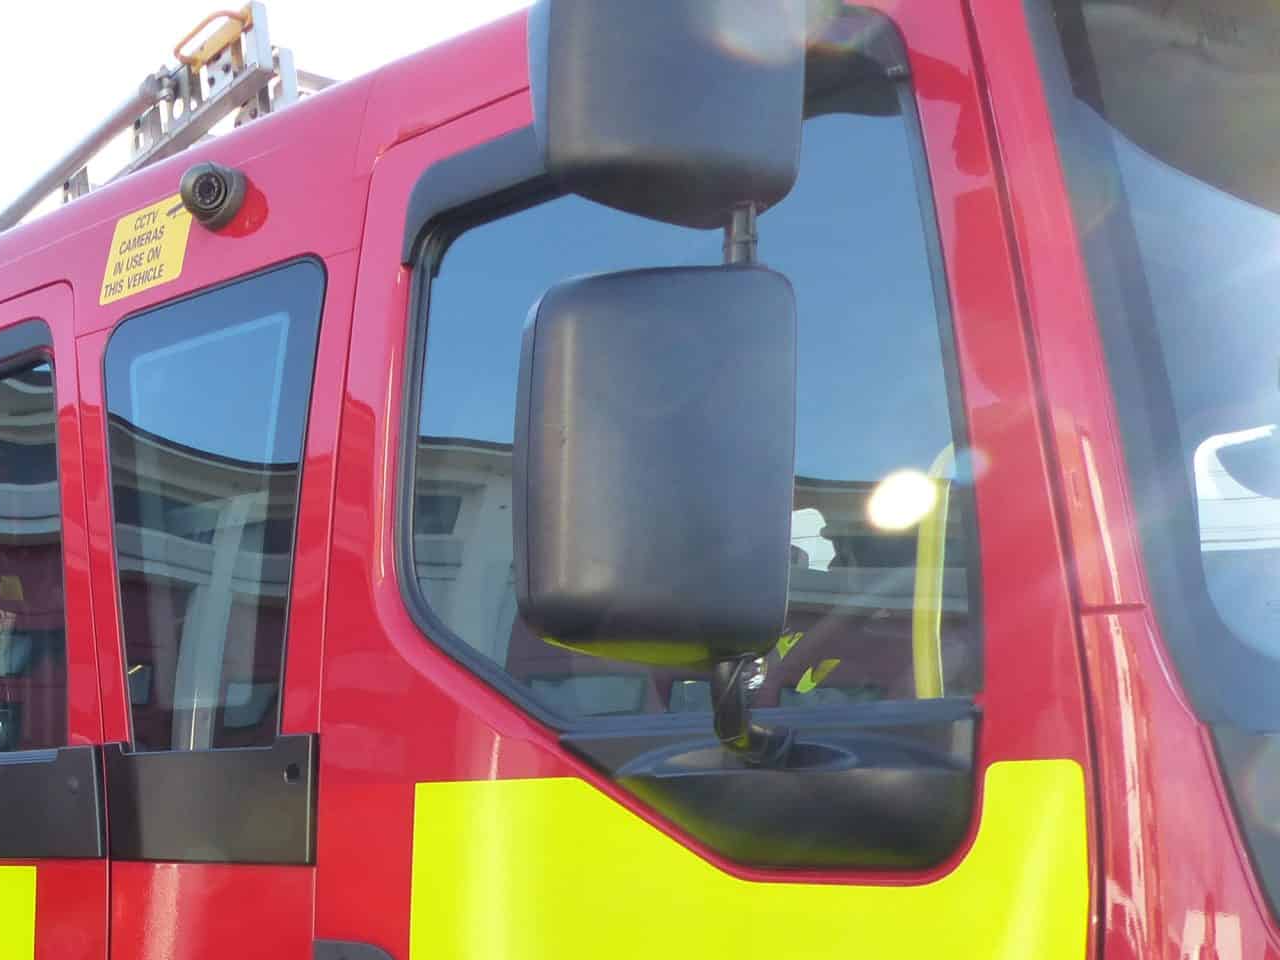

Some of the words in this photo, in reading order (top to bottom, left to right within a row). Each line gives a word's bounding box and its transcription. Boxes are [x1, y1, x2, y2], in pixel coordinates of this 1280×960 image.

[135, 210, 159, 230] CCTV
[119, 225, 165, 255] CAMERAS
[113, 259, 124, 276] IN
[126, 252, 144, 271] USE
[147, 245, 162, 263] ON
[104, 279, 124, 298] THIS
[127, 264, 165, 289] VEHICLE
